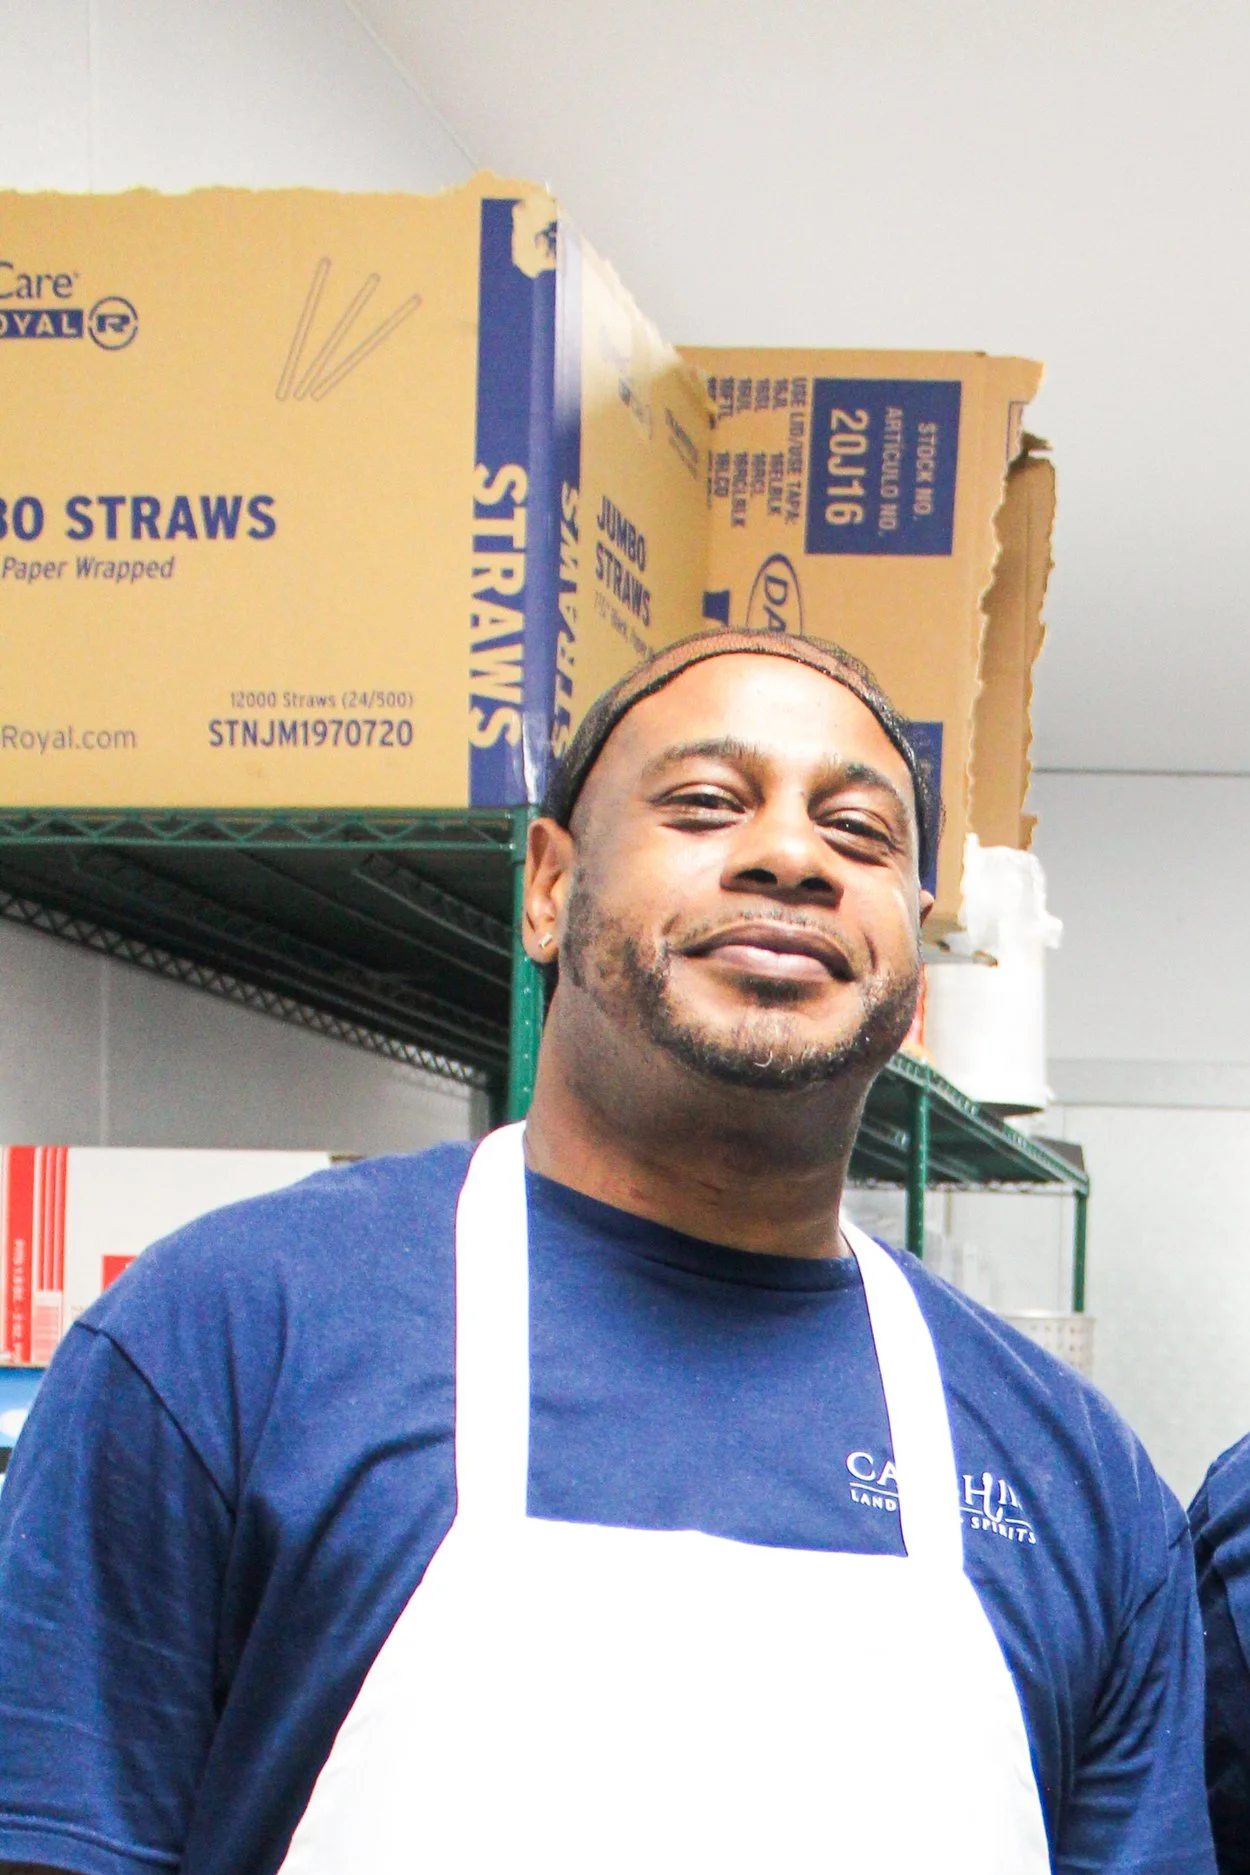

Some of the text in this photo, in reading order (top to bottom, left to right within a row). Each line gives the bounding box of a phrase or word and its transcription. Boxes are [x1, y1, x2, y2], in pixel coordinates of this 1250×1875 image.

[825, 408, 870, 526] 20J16
[916, 422, 938, 483] STOCK
[65, 495, 277, 541] STRAWS
[597, 495, 646, 572] JUMBO
[2, 556, 175, 584] Paper Wrapped
[595, 540, 651, 628] STRAWS
[468, 463, 529, 750] STRAWS
[230, 691, 414, 709] 12000 Straws (24/500)
[1, 725, 137, 755] Royal.com
[208, 719, 413, 749] STNJM1970720
[850, 1488, 1037, 1544] LAND SPIRITS
